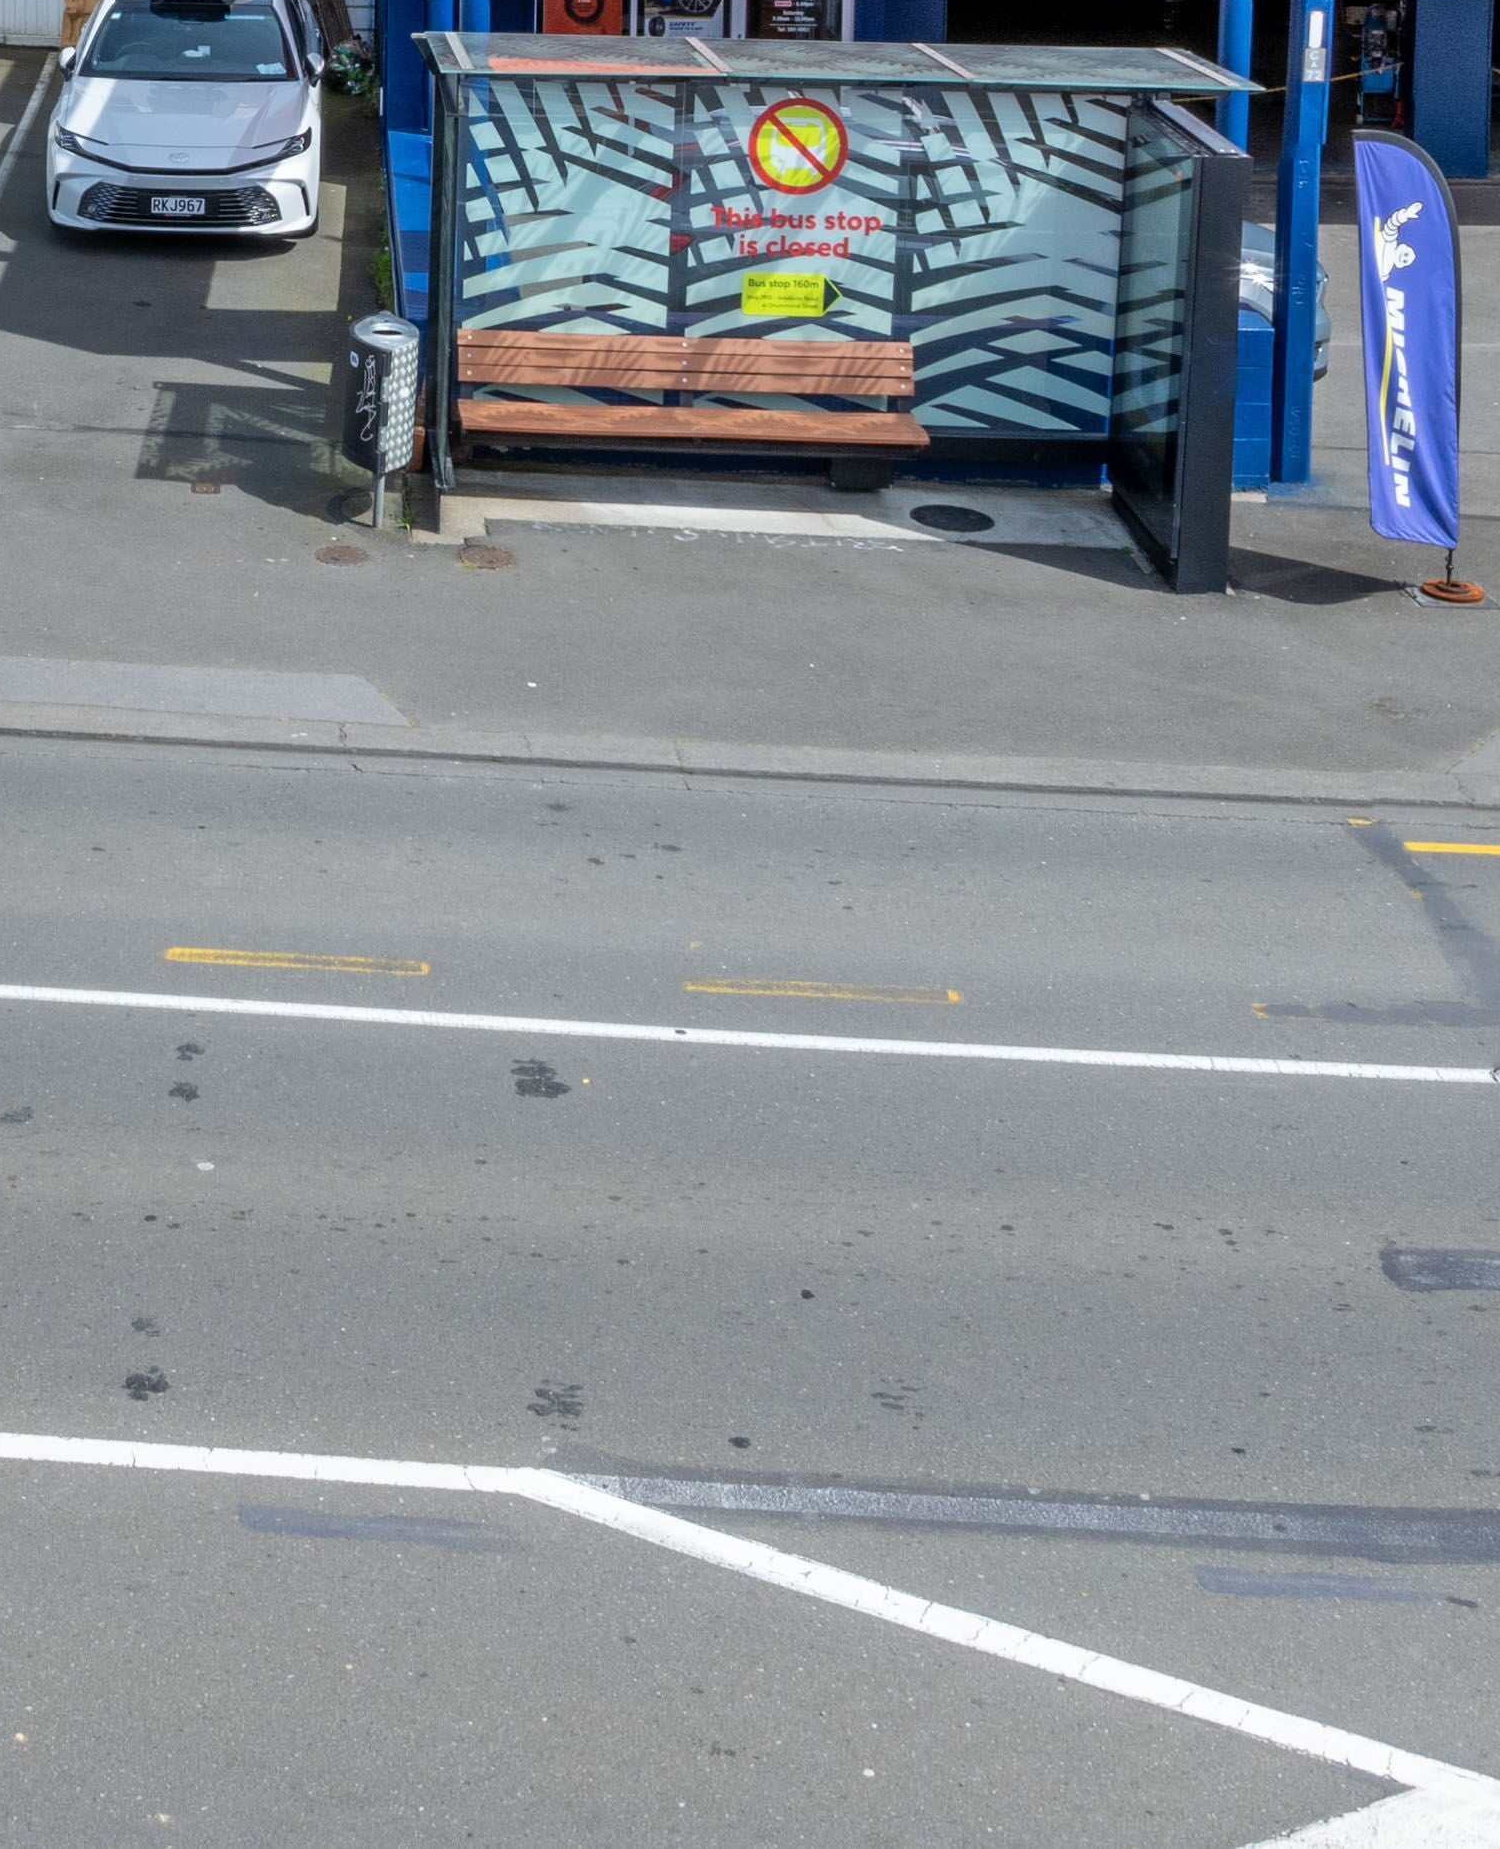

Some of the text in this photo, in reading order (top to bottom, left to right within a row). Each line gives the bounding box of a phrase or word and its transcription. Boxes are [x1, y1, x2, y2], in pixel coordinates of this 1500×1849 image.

[1310, 51, 1319, 61] C
[1307, 70, 1322, 80] 72
[152, 198, 204, 213] RKJ967
[711, 206, 882, 236] This bus stop
[738, 234, 851, 258] is closed
[748, 278, 819, 289] Bus stop 160m
